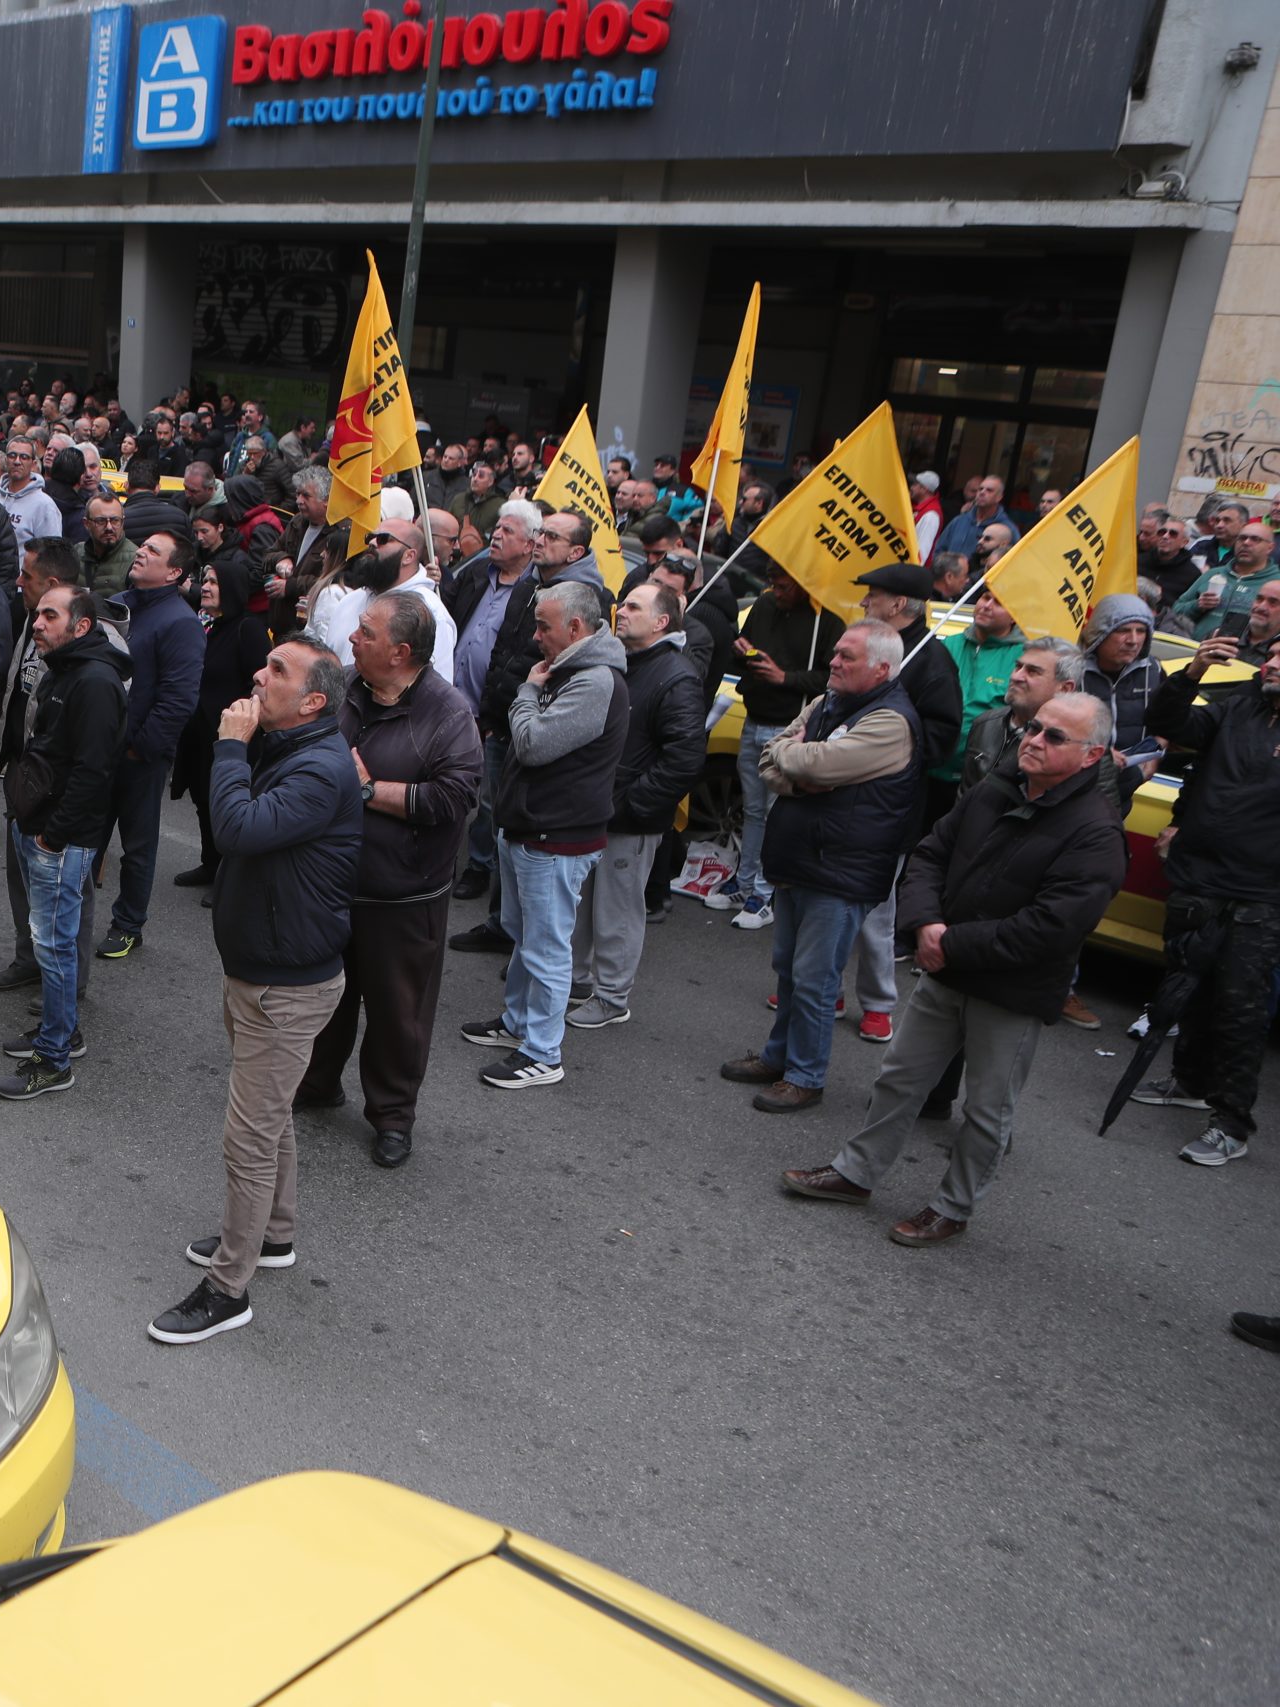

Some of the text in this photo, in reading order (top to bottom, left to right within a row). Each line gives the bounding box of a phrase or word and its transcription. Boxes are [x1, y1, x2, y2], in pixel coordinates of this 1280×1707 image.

[92, 25, 112, 154] ΣΥΝΕΡΓΑΤΗΣ
[302, 96, 356, 123] του
[499, 84, 541, 114] το
[543, 68, 658, 118] γάλα!
[814, 522, 851, 562] ΤΑΞΙ
[818, 498, 880, 560] ΑΓΩΝΑ
[823, 464, 911, 563] ΕΠΙΤΡΟΠΕΣ
